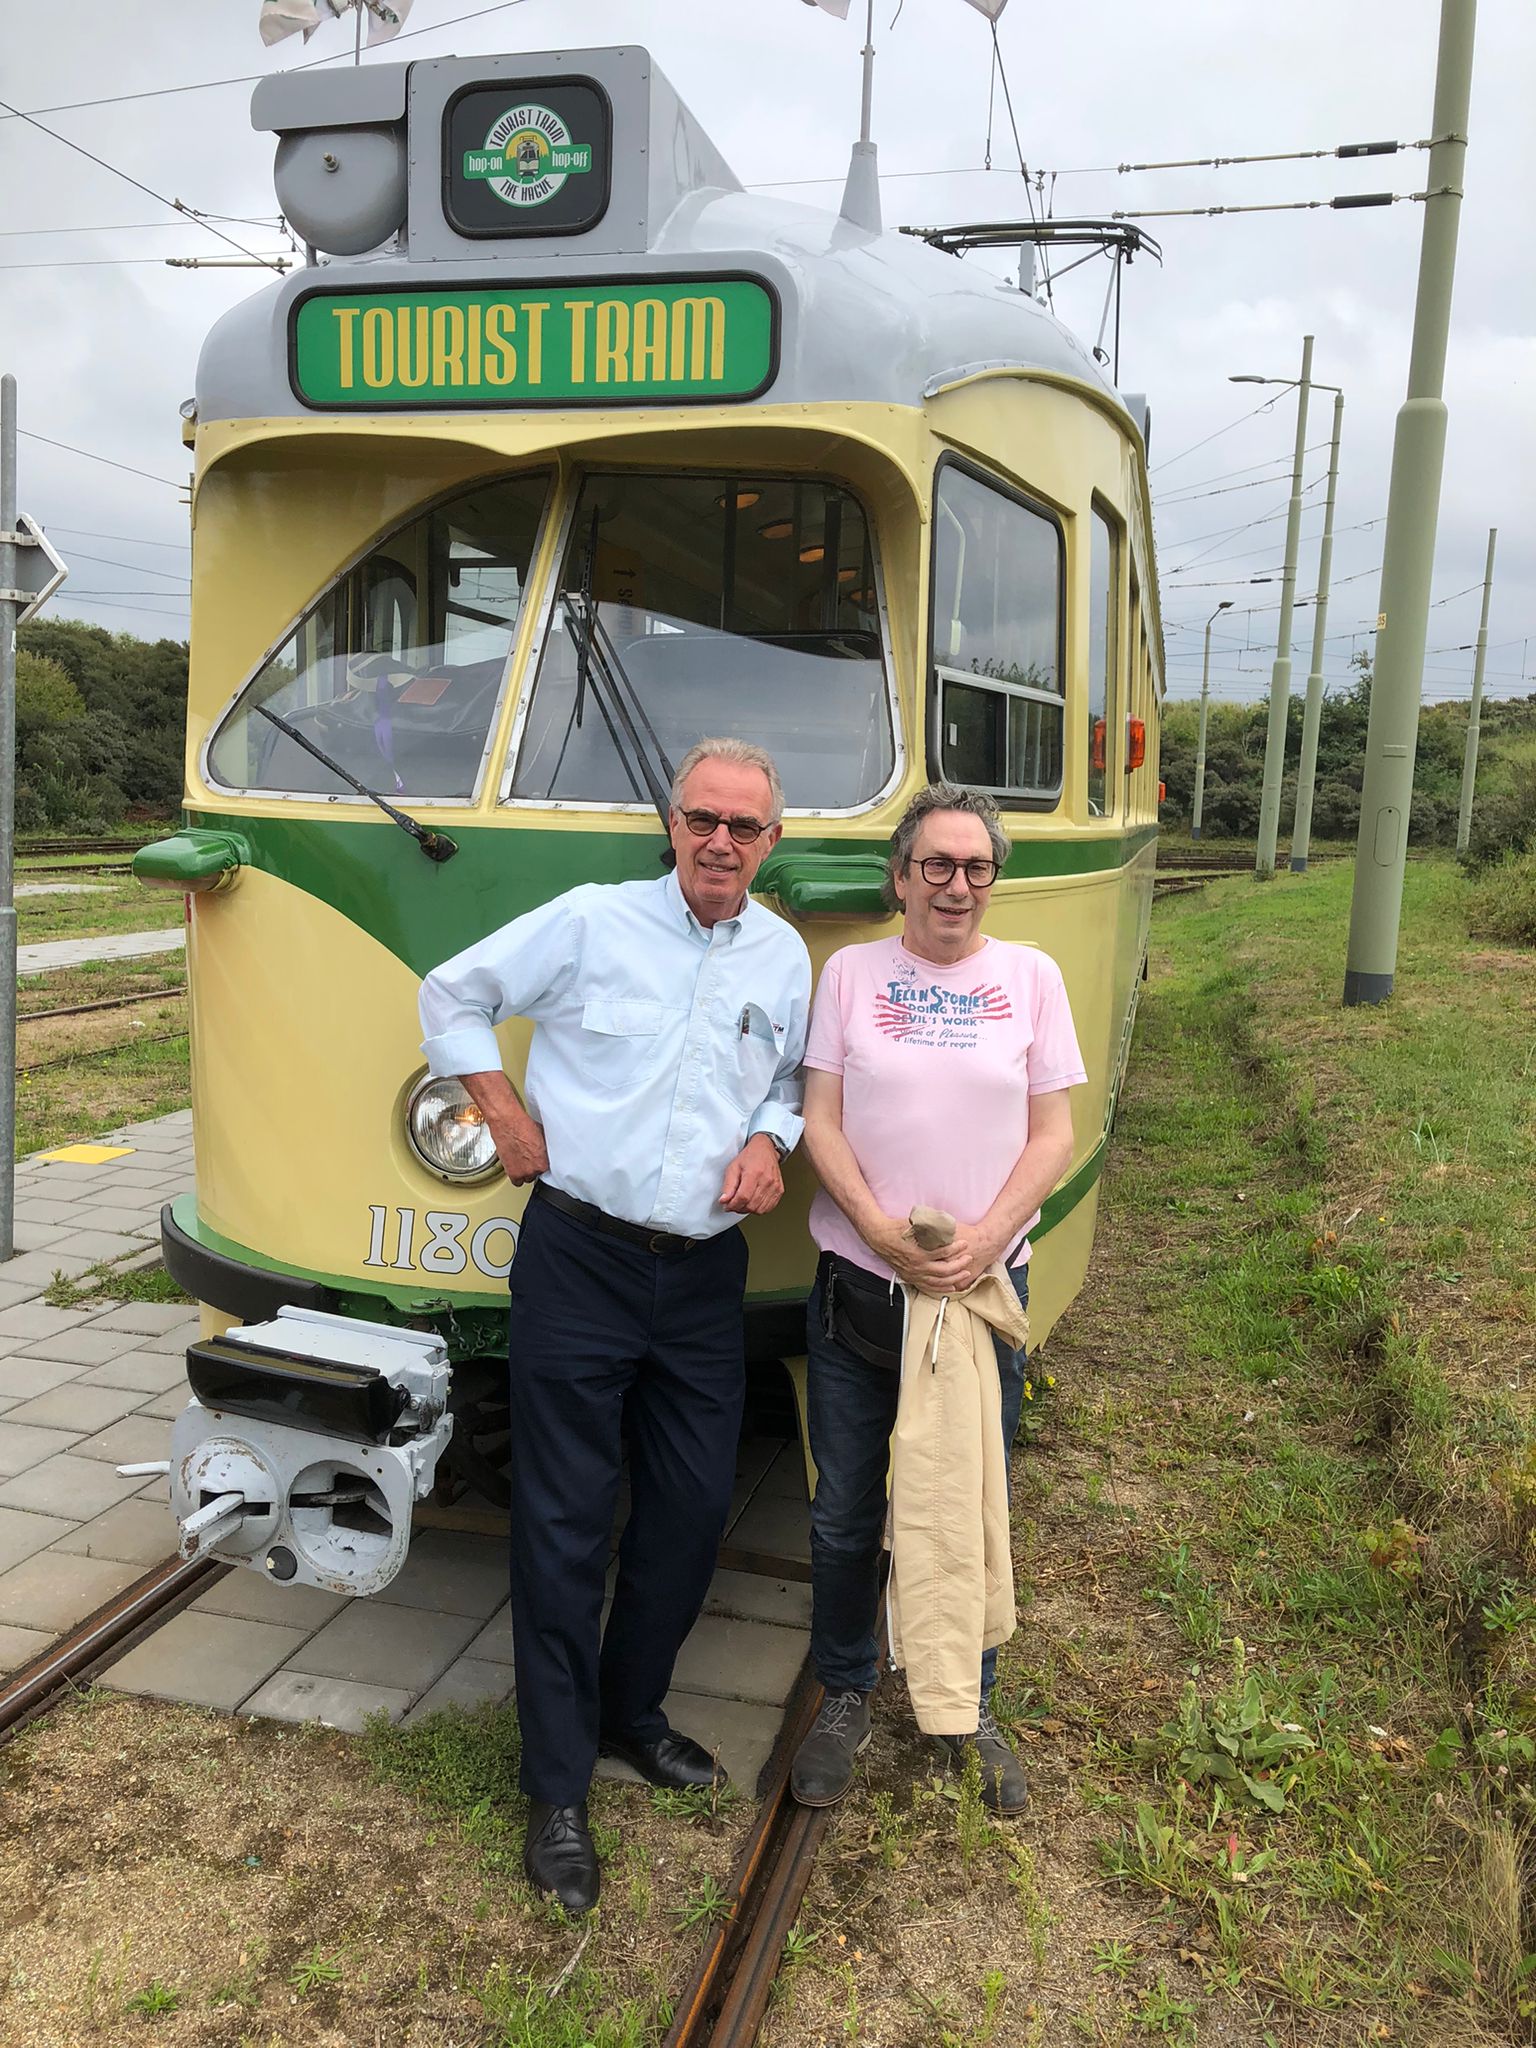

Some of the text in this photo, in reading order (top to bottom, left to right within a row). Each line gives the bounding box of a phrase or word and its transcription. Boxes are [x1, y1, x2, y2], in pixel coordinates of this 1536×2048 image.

[490, 109, 565, 147] TOURIST TRAM
[500, 177, 554, 201] THE HAGUE
[332, 296, 726, 388] TOURIST TRAM
[909, 1003, 948, 1014] DOING
[904, 1037, 935, 1047] lifetime
[950, 1041, 977, 1050] regret
[363, 1205, 521, 1279] 1180
